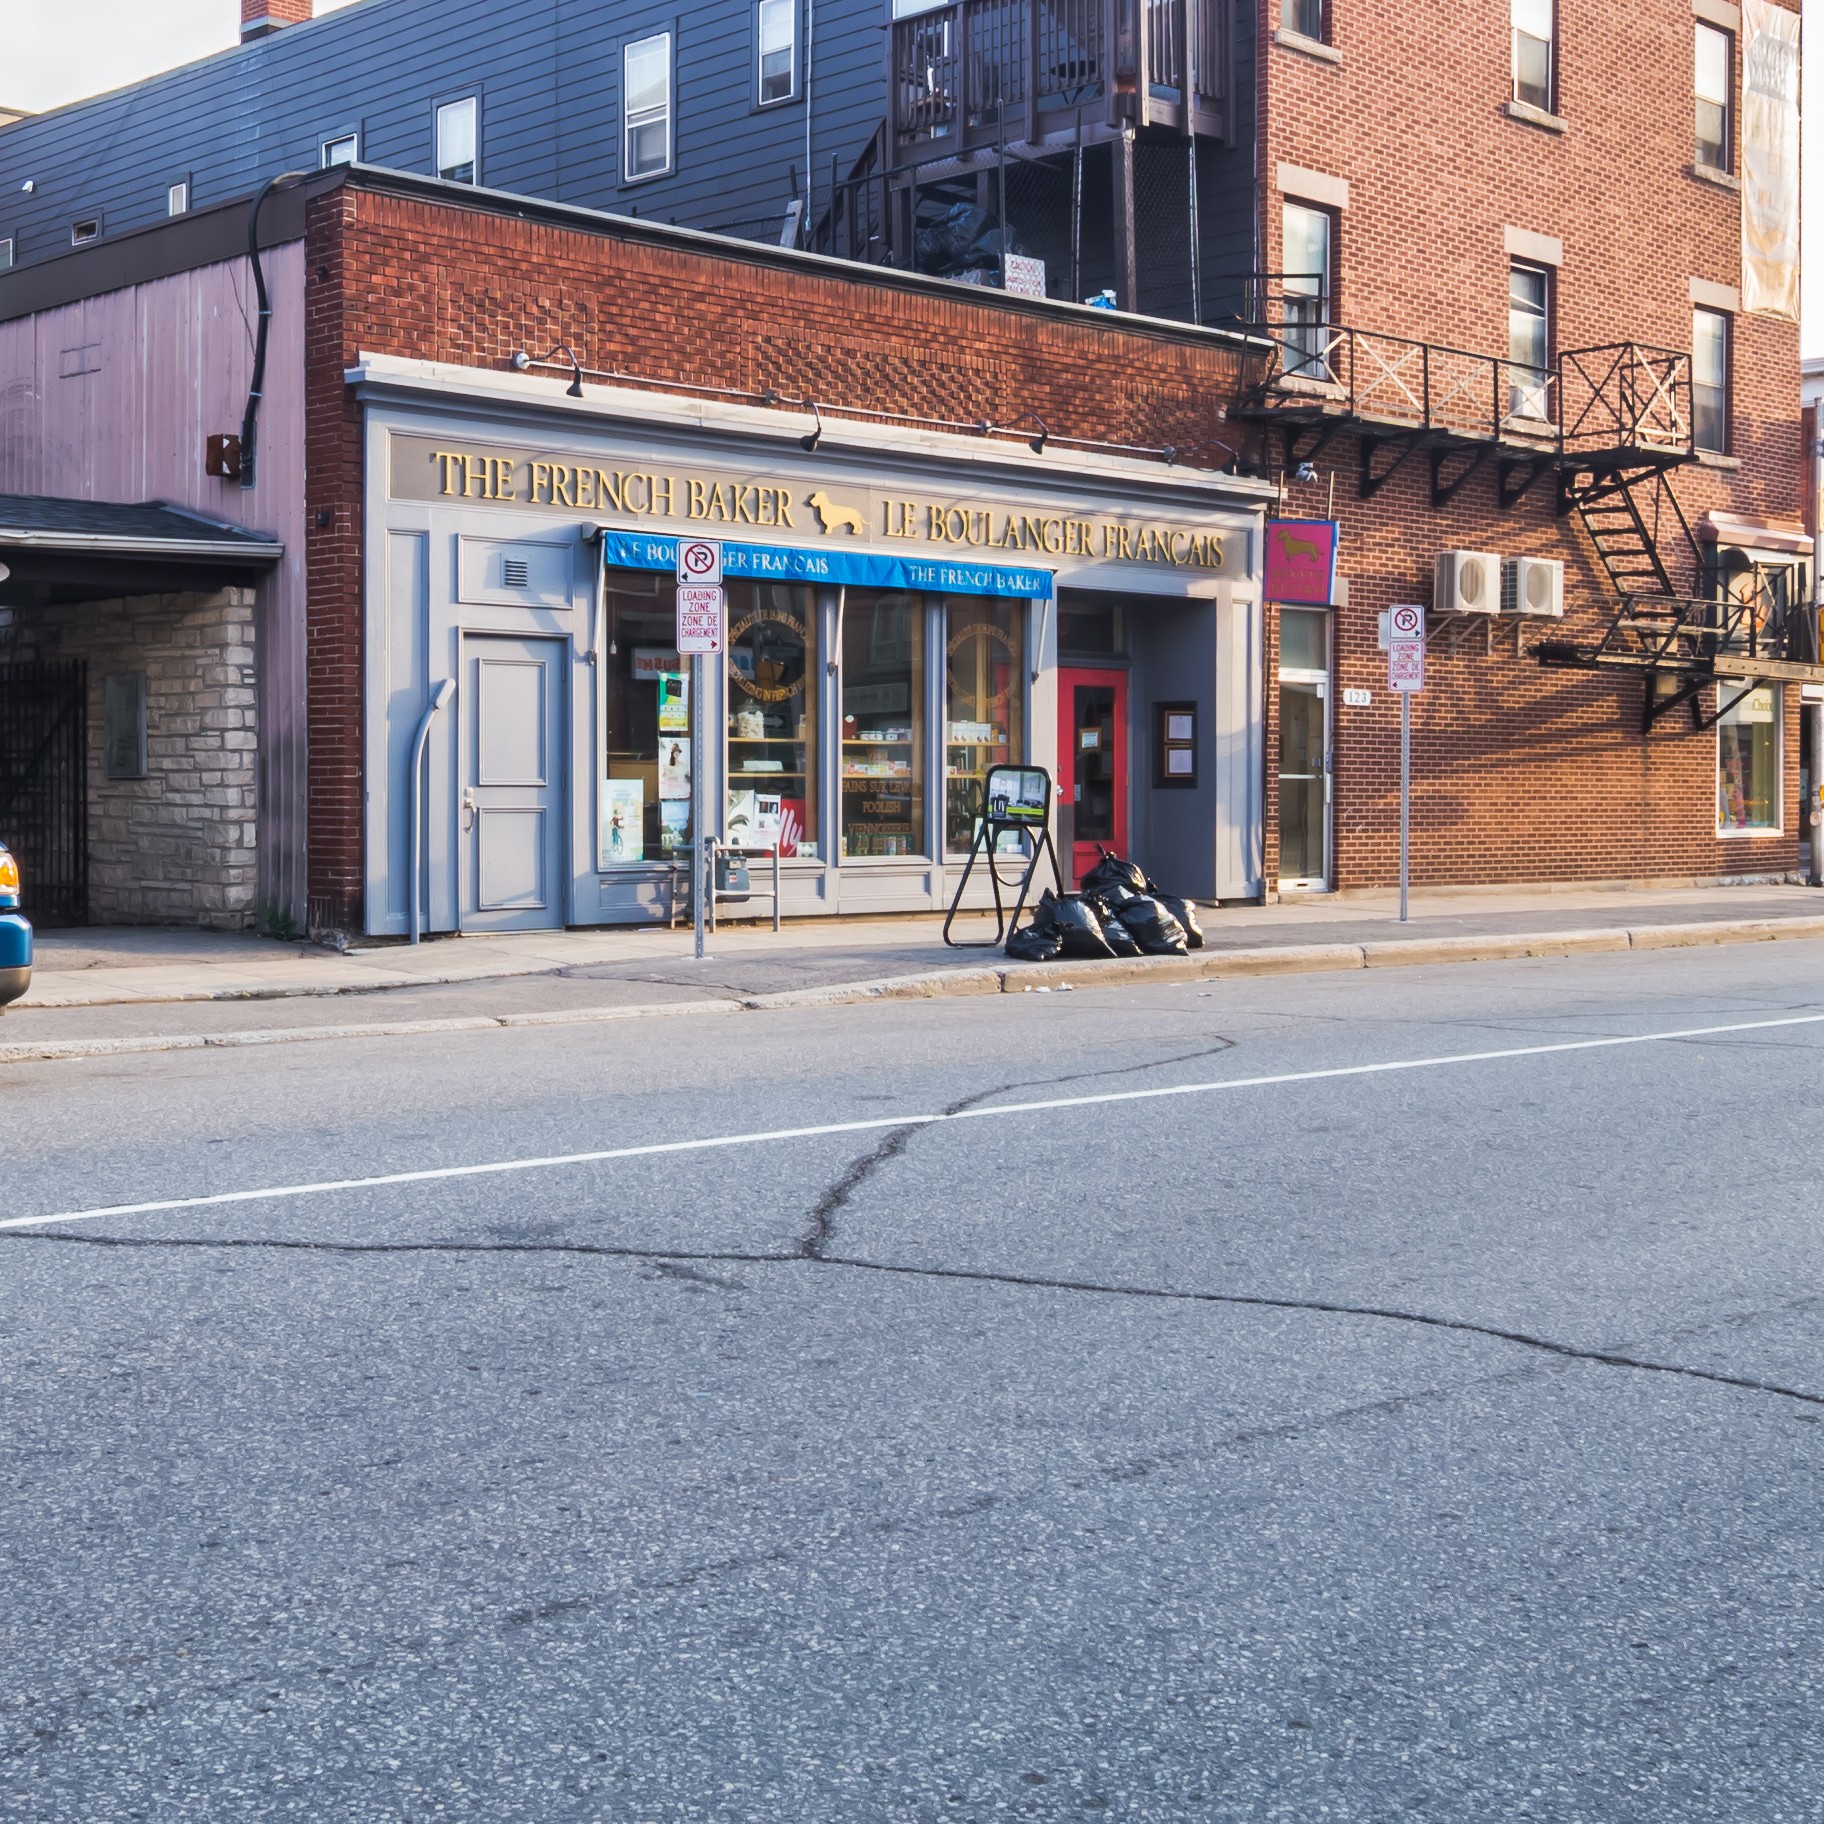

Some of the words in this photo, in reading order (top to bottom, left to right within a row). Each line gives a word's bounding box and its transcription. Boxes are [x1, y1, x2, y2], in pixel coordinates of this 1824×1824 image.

[432, 451, 517, 502] THE
[529, 461, 677, 516] FRENCH
[686, 478, 797, 528] BAKER
[884, 499, 919, 539] LE
[928, 504, 1096, 557] BOULANGER
[1102, 523, 1225, 568] FRANÇAIS
[646, 546, 747, 569] BOUER
[909, 565, 936, 582] THE
[940, 568, 993, 587] FRENCH
[996, 573, 1041, 591] BAKER
[682, 590, 717, 601] LOADING
[688, 602, 710, 613] ZONE
[681, 615, 703, 627] ZONE
[707, 616, 718, 627] DE
[681, 627, 718, 638] CHARGEMENT
[1392, 643, 1420, 653] LOADING
[1397, 652, 1414, 661] ZONE
[1392, 662, 1409, 671] ZONE
[1411, 662, 1420, 672] DE
[1391, 671, 1421, 680] CHARGEMENT
[1348, 692, 1367, 703] 123
[862, 800, 901, 813] POOLISH
